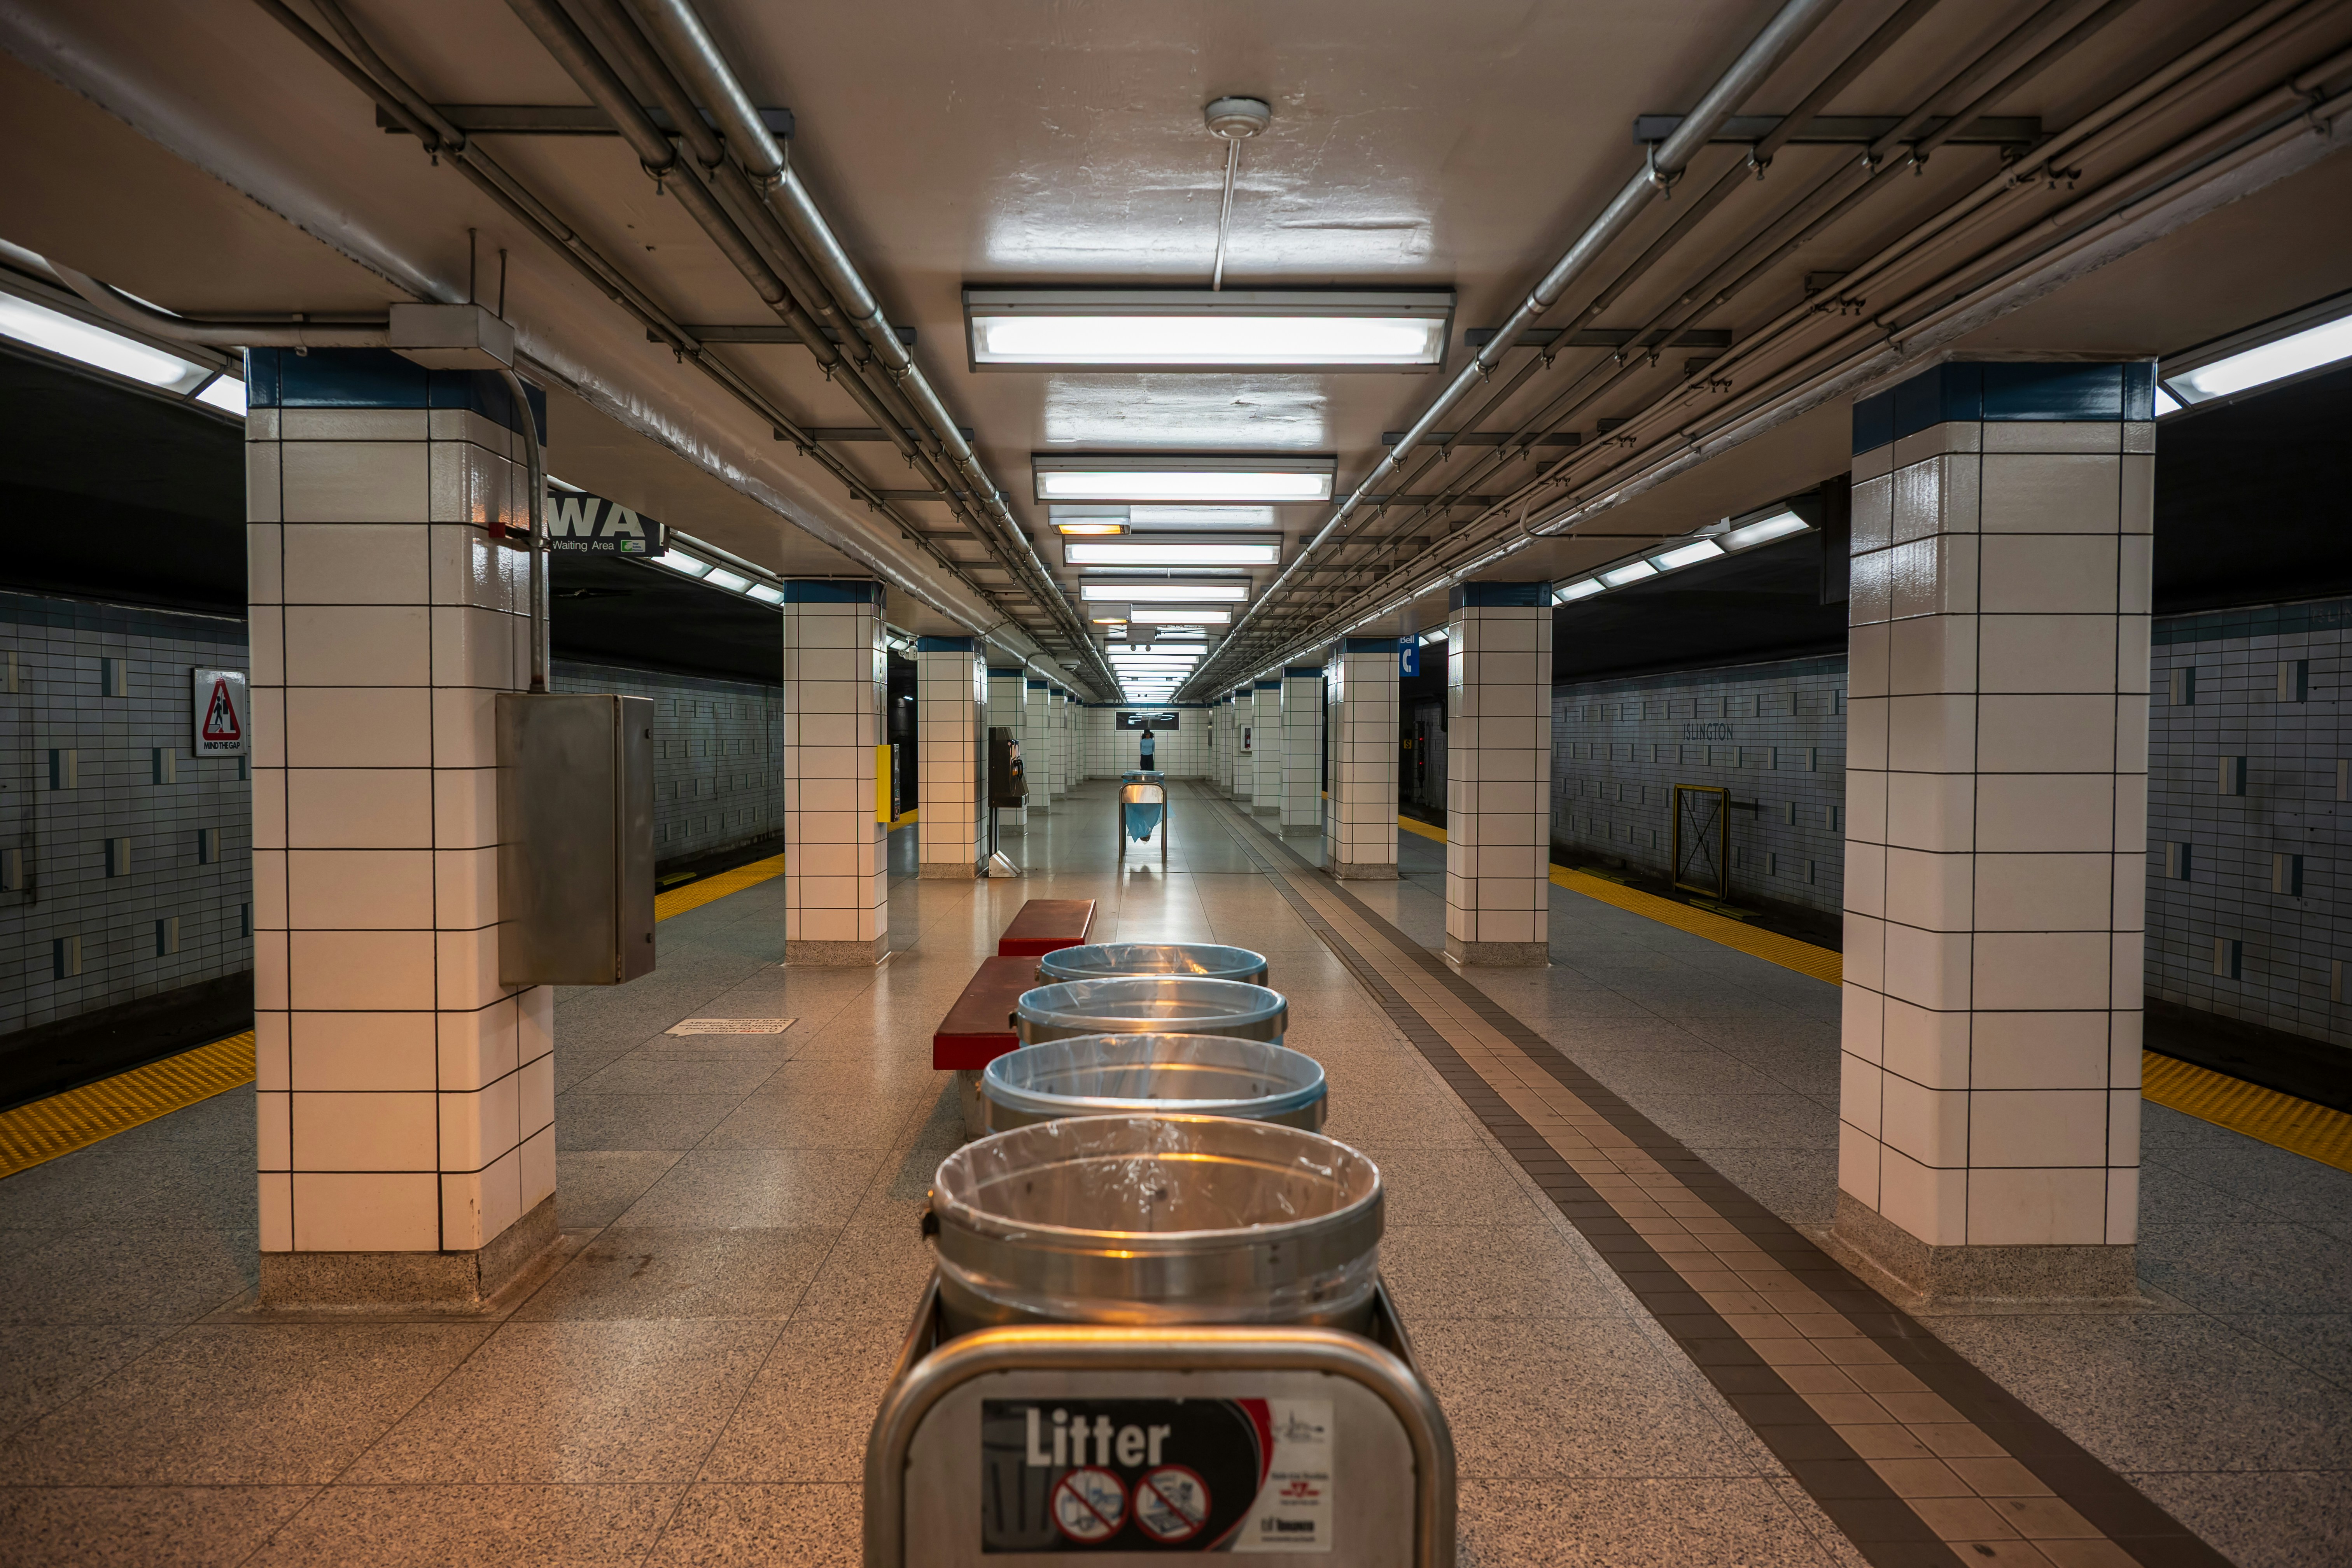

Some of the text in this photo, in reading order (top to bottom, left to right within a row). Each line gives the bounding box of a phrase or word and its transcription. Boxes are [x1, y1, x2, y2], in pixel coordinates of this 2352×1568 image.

[553, 541, 614, 551] Waiting Area
[1400, 635, 1414, 643] Bell
[1683, 723, 1733, 741] ISLINGTON
[204, 742, 219, 750] MIND
[1405, 740, 1410, 748] S
[1026, 1408, 1171, 1467] Litter
